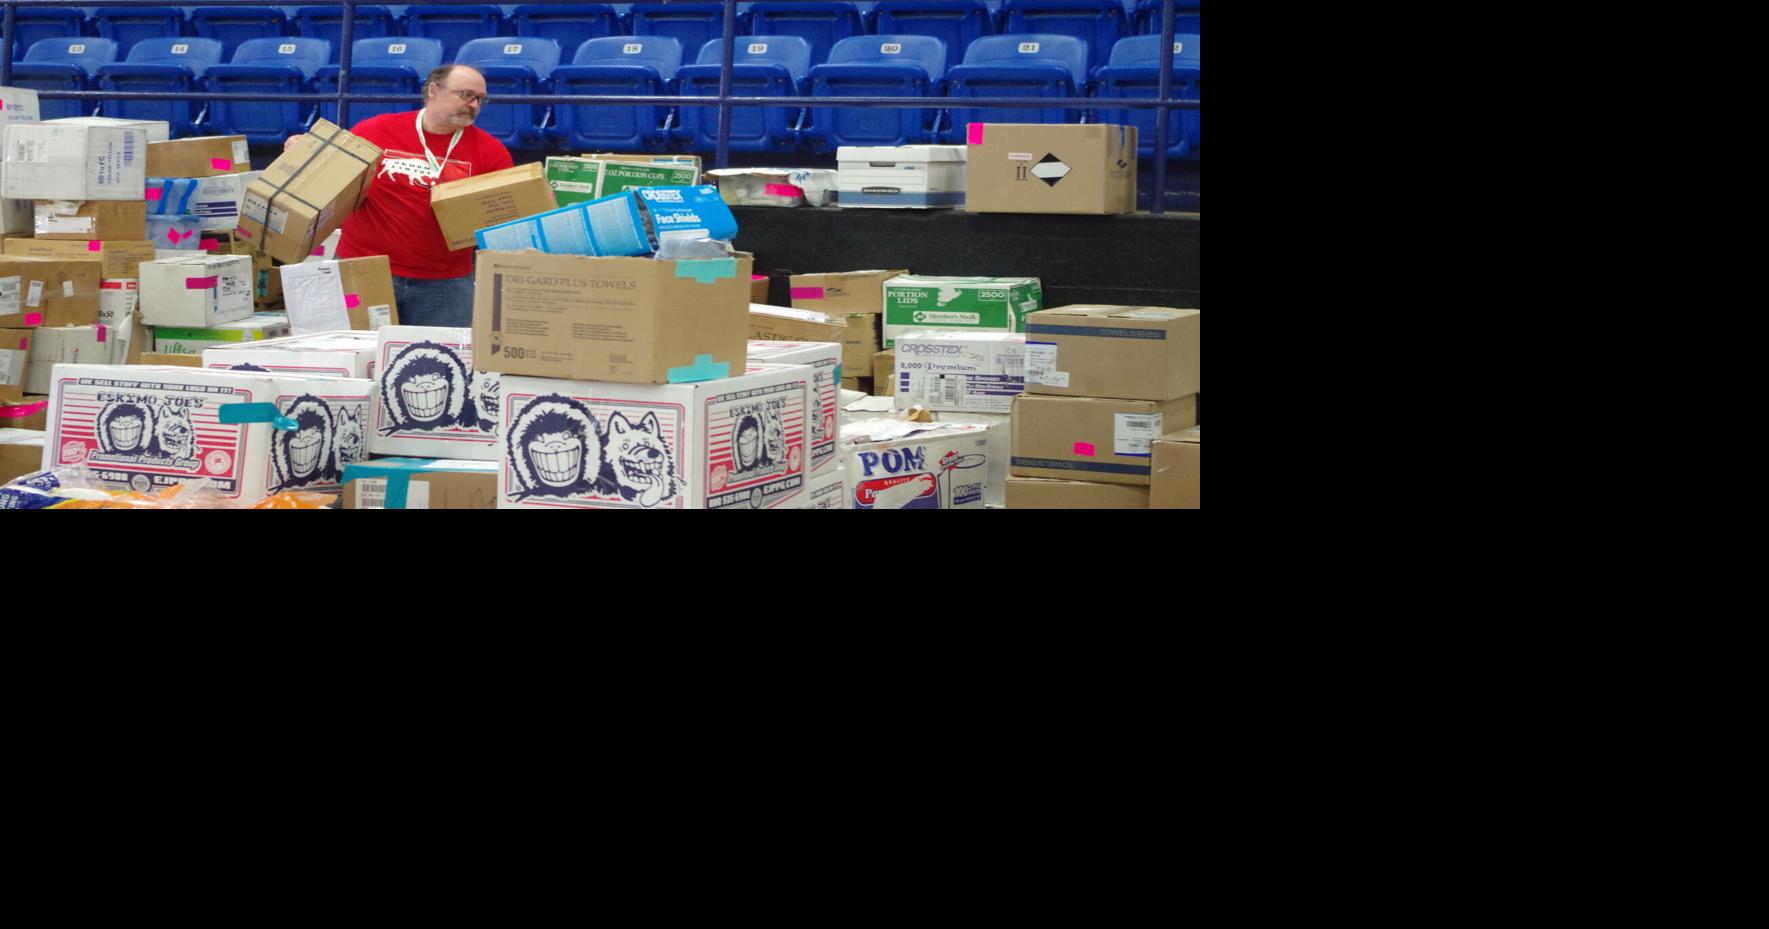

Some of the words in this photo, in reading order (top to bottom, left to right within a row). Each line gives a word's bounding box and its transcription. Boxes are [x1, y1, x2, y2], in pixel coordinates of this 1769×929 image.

[619, 170, 647, 178] PORTION
[506, 275, 558, 287] DRI-GARD
[561, 278, 587, 287] PLUS
[589, 279, 636, 289] TOWELS
[504, 346, 525, 359] 500
[901, 344, 963, 356] CROSSTEX
[97, 391, 157, 405] ESKIMO
[164, 395, 205, 408] JOE'S
[730, 402, 762, 417] ESKIMO
[90, 451, 137, 461] Promotional
[138, 454, 176, 465] Products
[858, 446, 925, 476] POM
